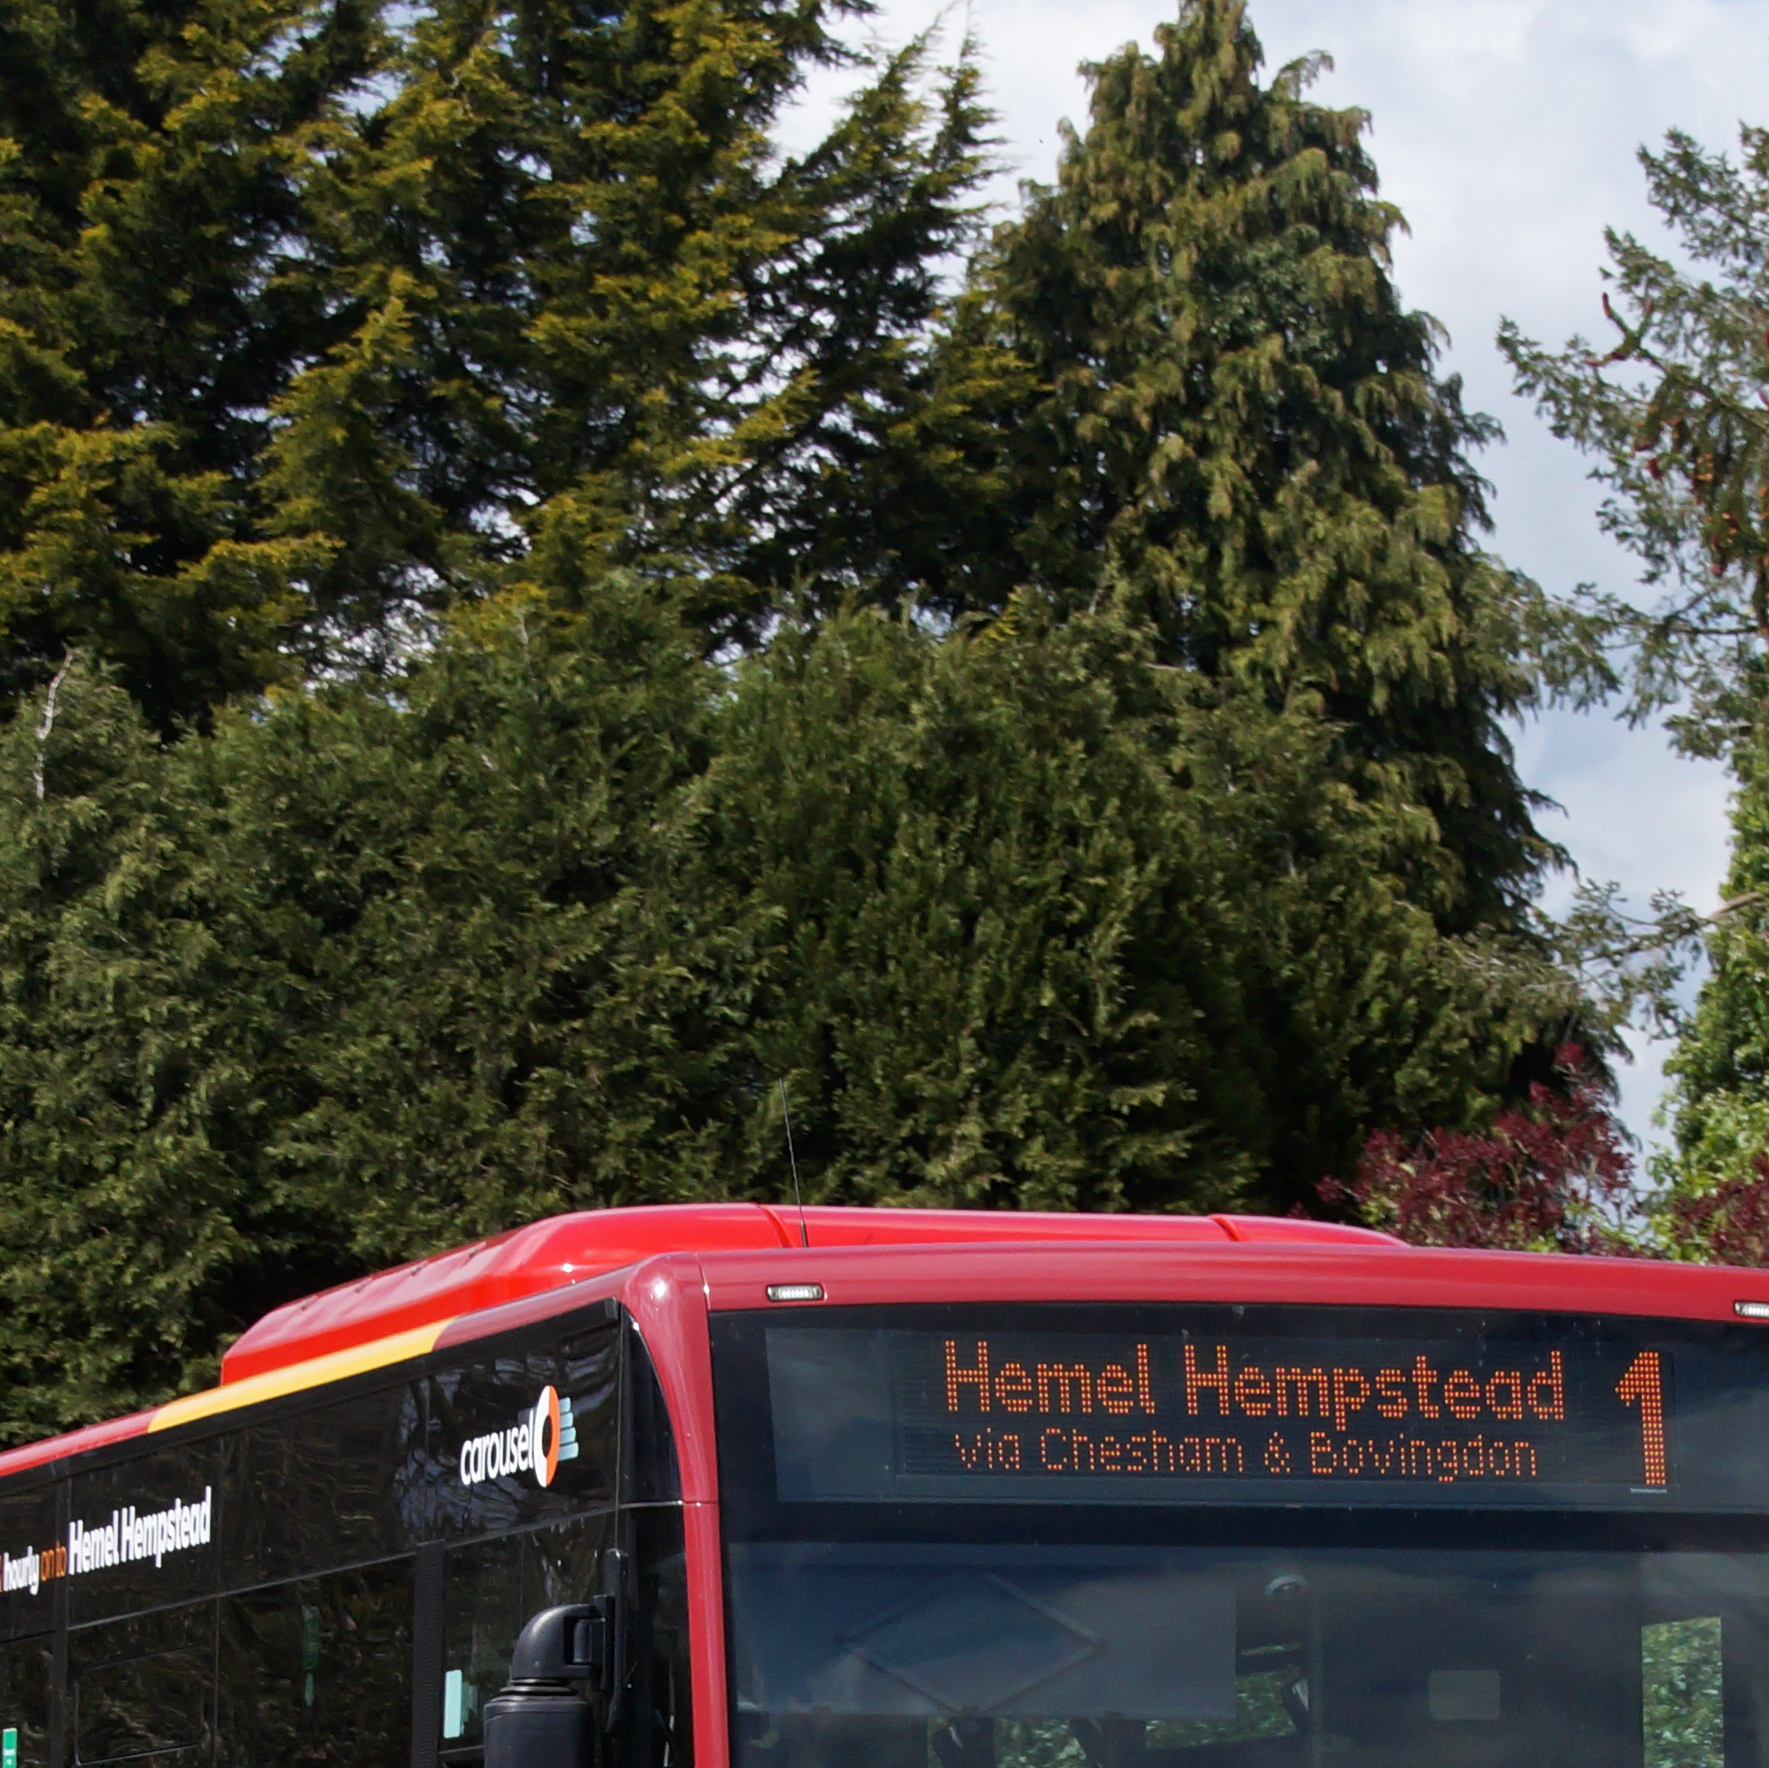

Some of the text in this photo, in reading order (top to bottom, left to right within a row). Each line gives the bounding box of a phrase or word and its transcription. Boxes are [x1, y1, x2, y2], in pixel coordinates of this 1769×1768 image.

[944, 1340, 1564, 1431] Hemel Hempstead
[1614, 1351, 1666, 1485] 1
[460, 1409, 534, 1486] carousel
[954, 1427, 1537, 1482] via Chesham & Bovingdon
[2, 1545, 40, 1596] hourly
[68, 1519, 119, 1576] Hemel
[119, 1485, 212, 1568] Hempstead
